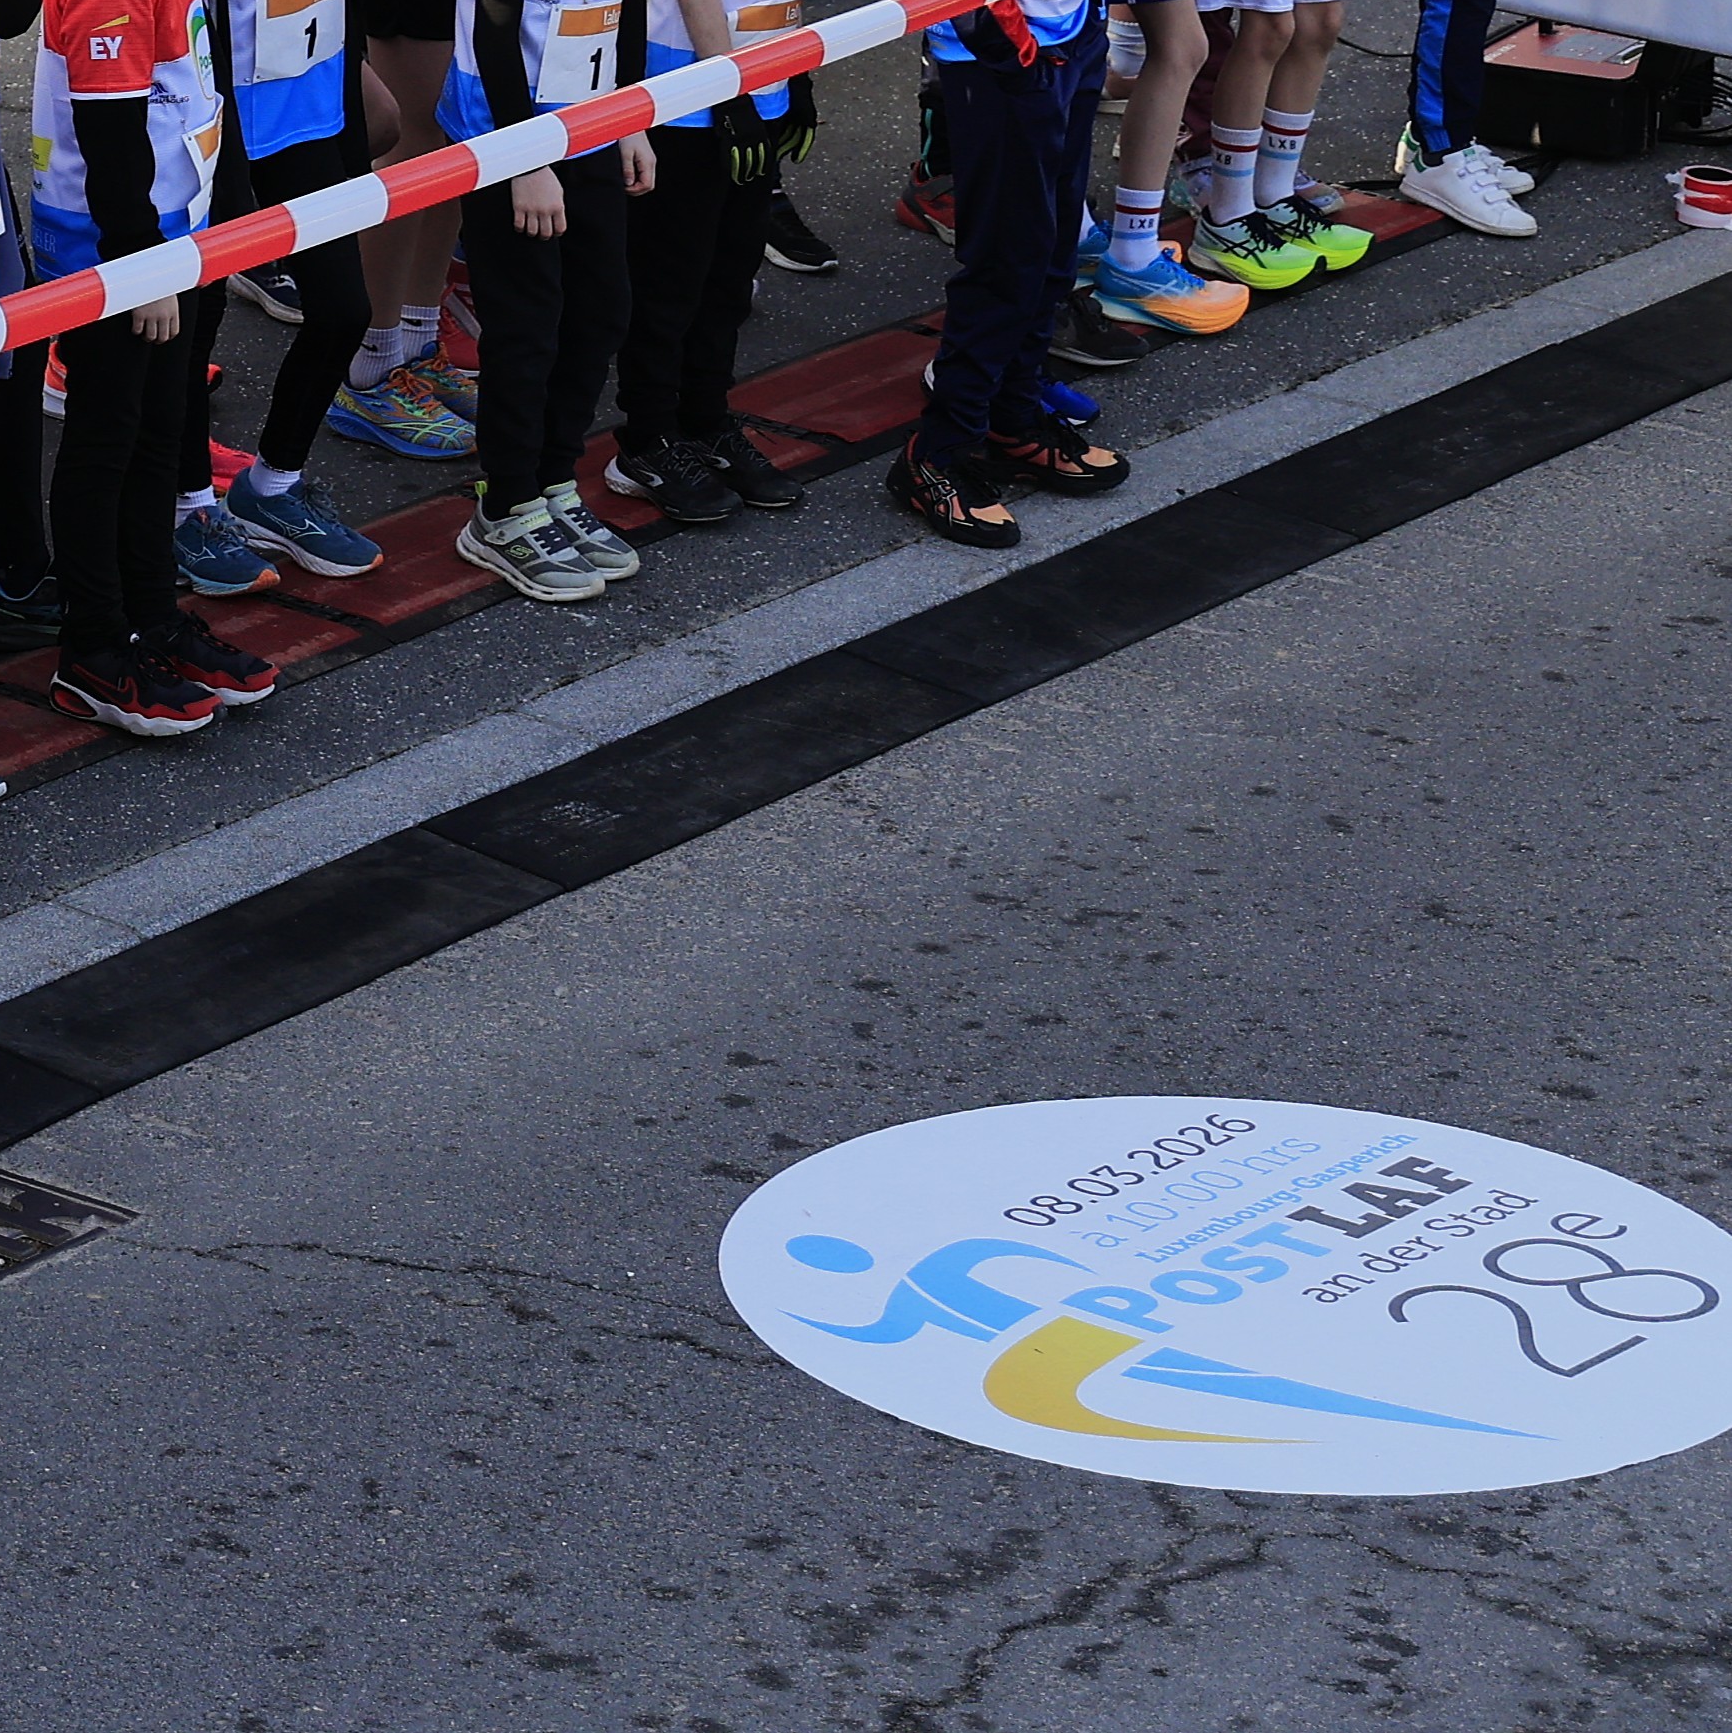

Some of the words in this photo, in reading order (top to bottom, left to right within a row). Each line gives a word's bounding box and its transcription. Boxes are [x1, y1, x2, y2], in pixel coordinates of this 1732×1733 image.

[89, 35, 123, 61] EY
[303, 16, 318, 60] 1
[602, 8, 621, 26] lalu
[589, 47, 603, 91] 1
[1267, 135, 1298, 150] LXB
[1128, 217, 1155, 230] LXB
[1003, 1112, 1258, 1229] 08.03.2026
[1077, 1225, 1129, 1250] à
[1104, 1166, 1245, 1234] 10:00
[1233, 1134, 1323, 1182] hrs
[1135, 1131, 1421, 1265] Luxembourg-Gasperich
[1060, 1221, 1338, 1335] POST
[1287, 1156, 1474, 1240] LAF
[1301, 1265, 1376, 1305] an
[1359, 1225, 1445, 1277] der
[1423, 1188, 1539, 1242] Stad
[1387, 1211, 1722, 1379] 28e
